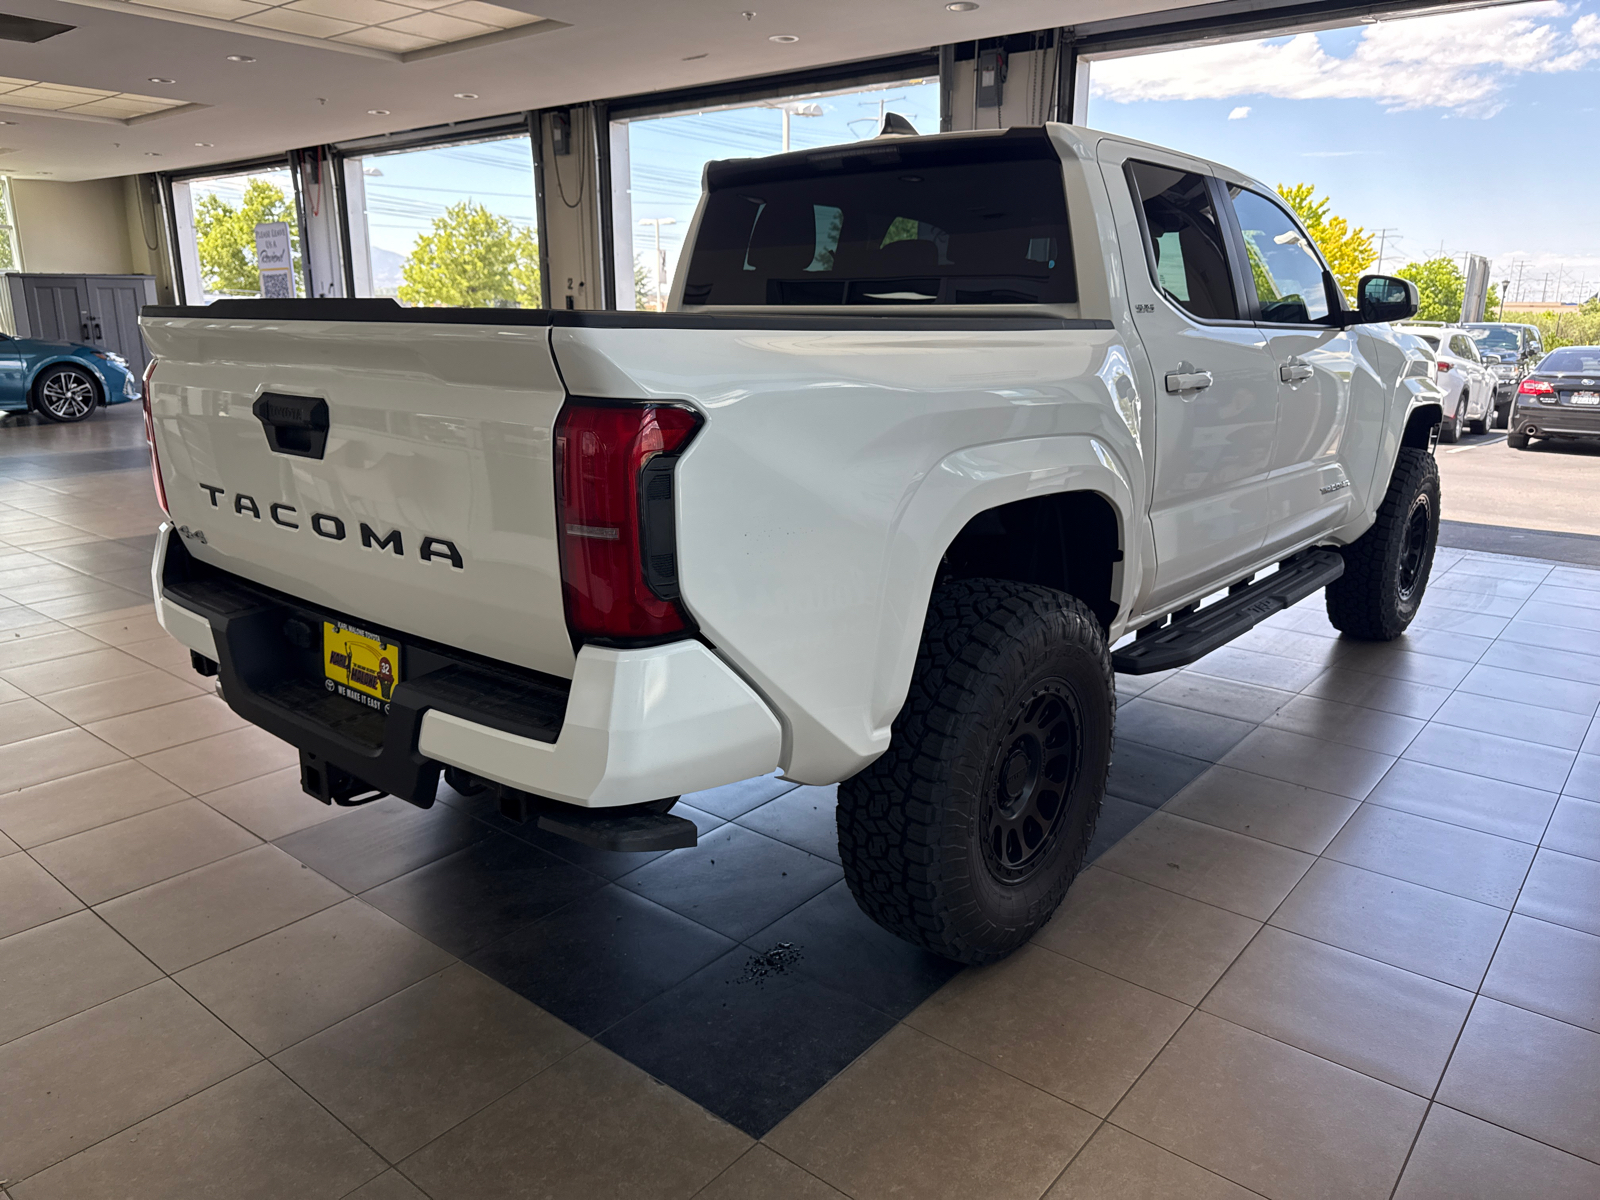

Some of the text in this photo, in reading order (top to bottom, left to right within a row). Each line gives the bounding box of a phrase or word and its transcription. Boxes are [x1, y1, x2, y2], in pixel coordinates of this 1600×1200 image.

[567, 278, 573, 290] 2
[199, 482, 464, 569] TACOMA
[351, 667, 378, 690] MALONE
[381, 662, 390, 674] 32
[338, 685, 381, 710] WE MAKE IT EASY
